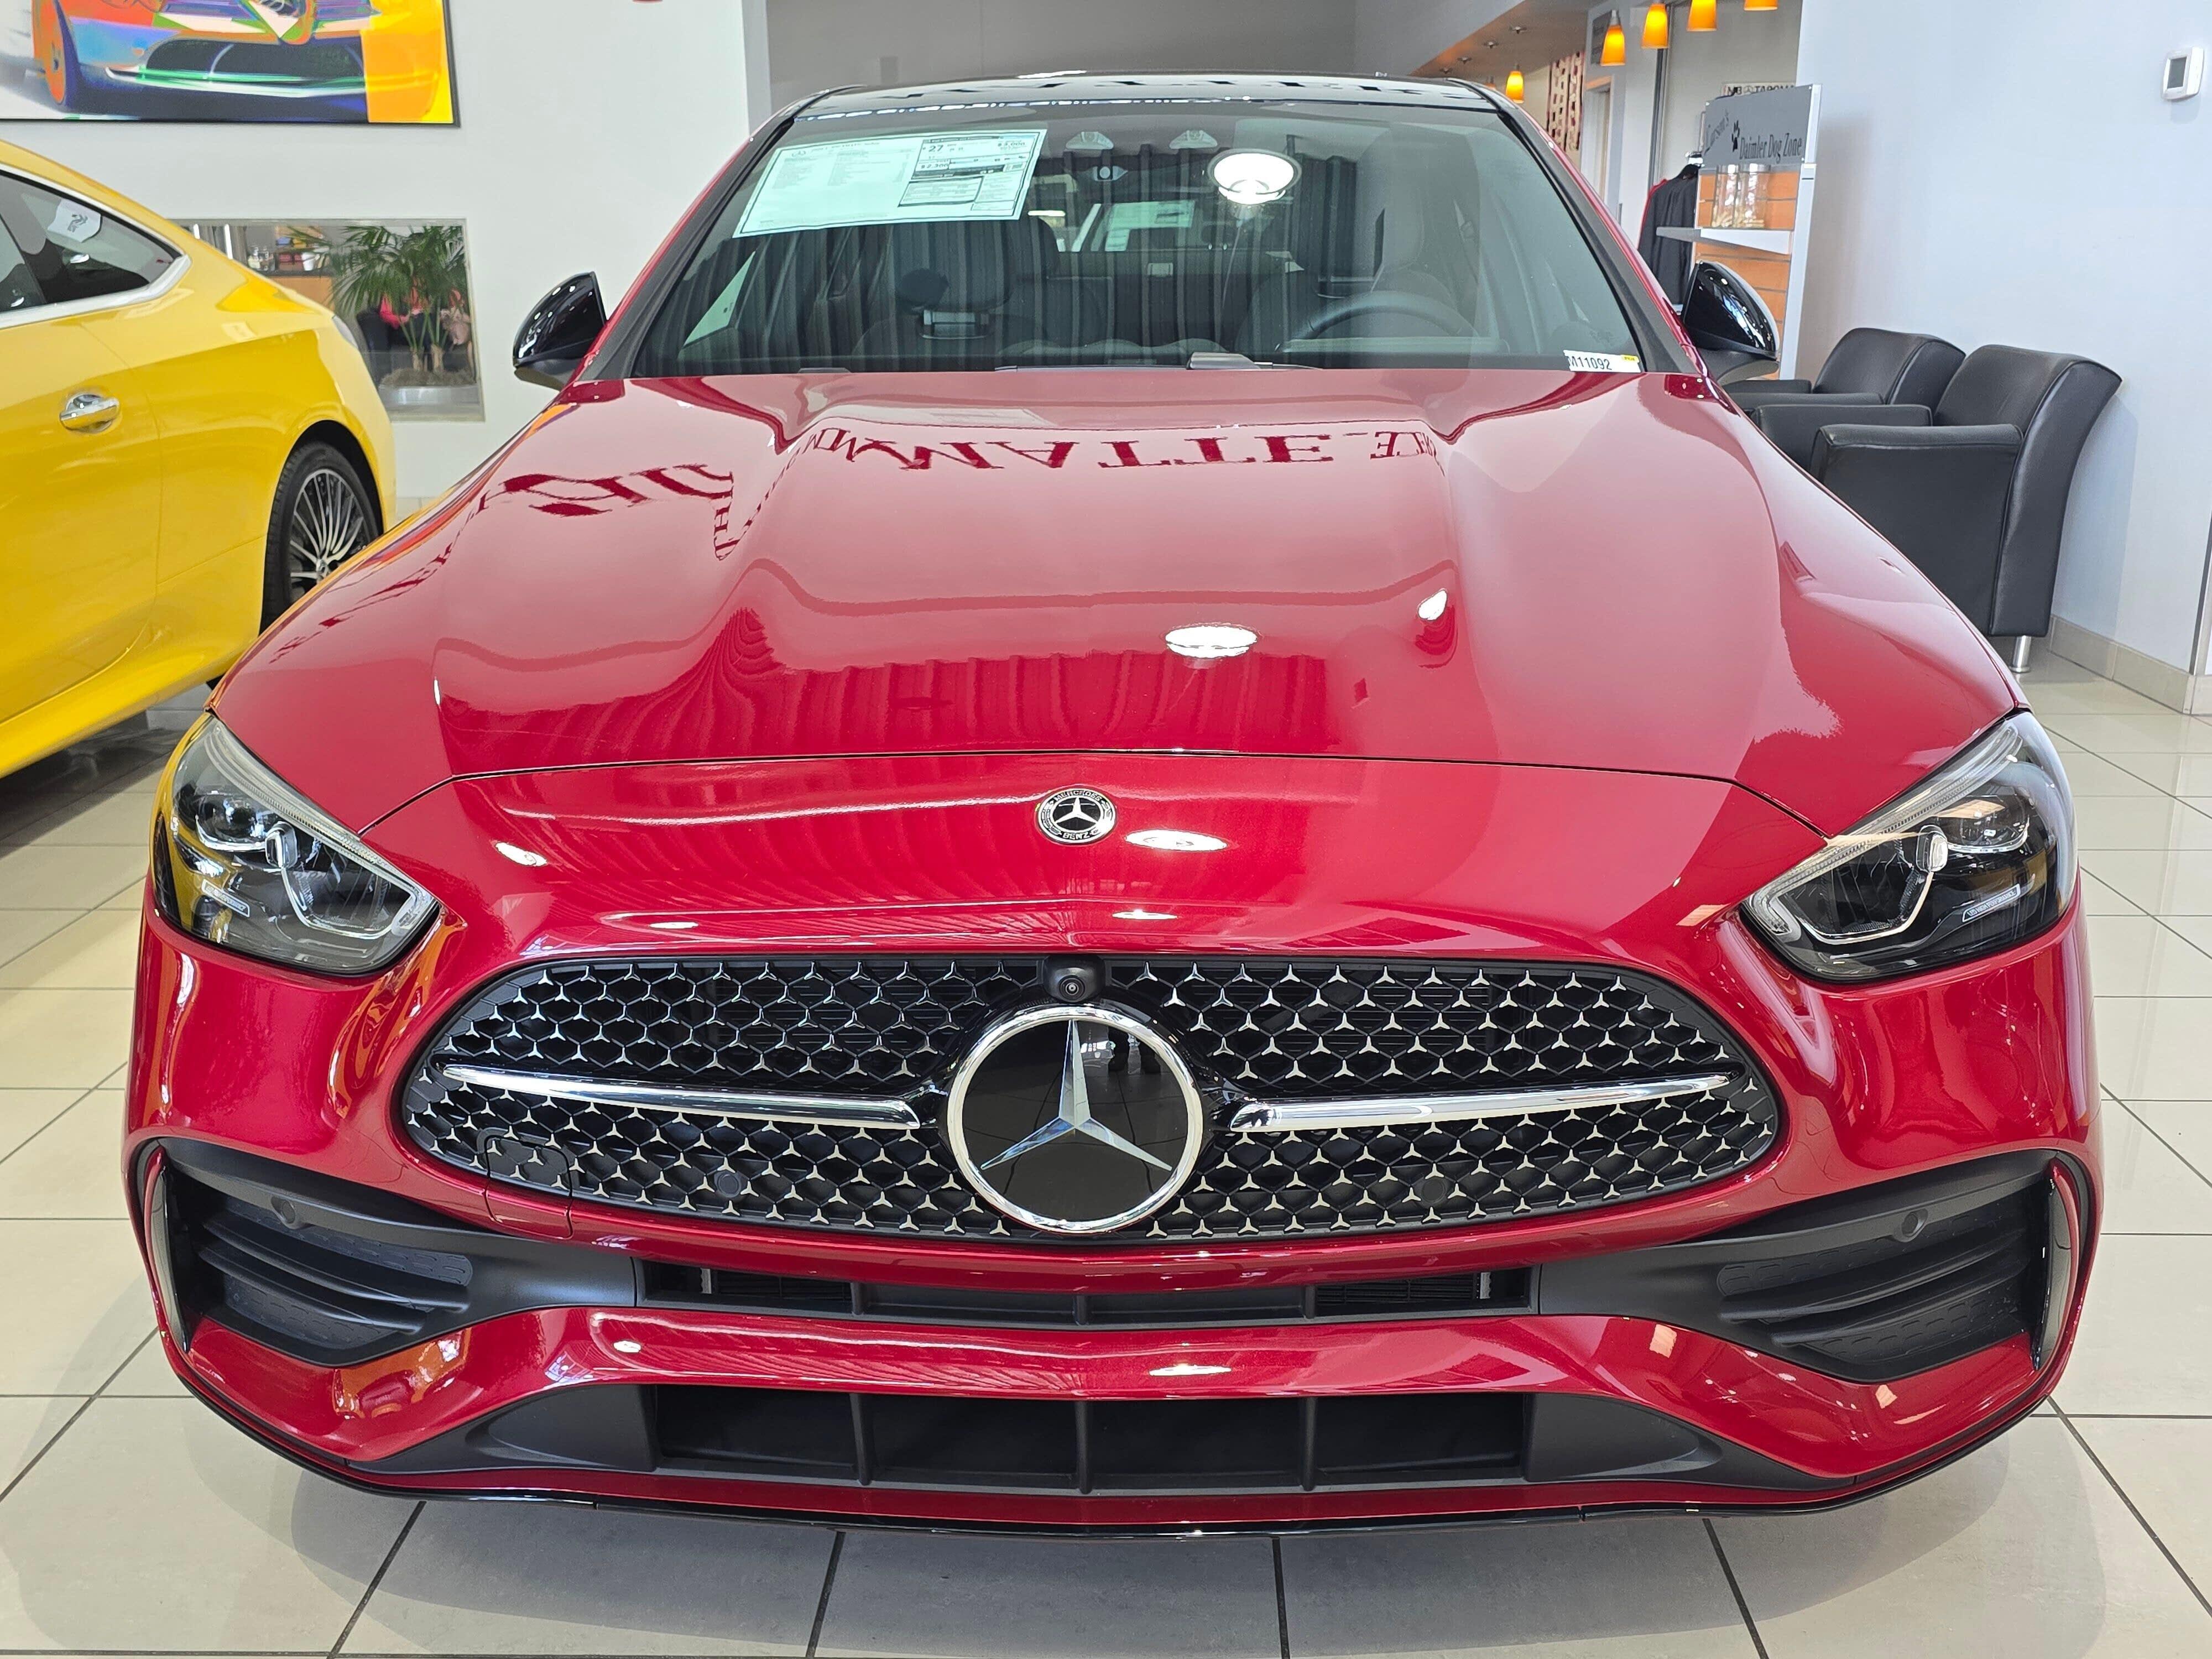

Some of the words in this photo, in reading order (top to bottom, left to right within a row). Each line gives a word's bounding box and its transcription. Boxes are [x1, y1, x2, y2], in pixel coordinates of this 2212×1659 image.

[1739, 135, 1767, 160] Daimler
[1768, 134, 1782, 164] Dog
[1782, 132, 1802, 156] Zone
[1062, 831, 1091, 840] BENZ
